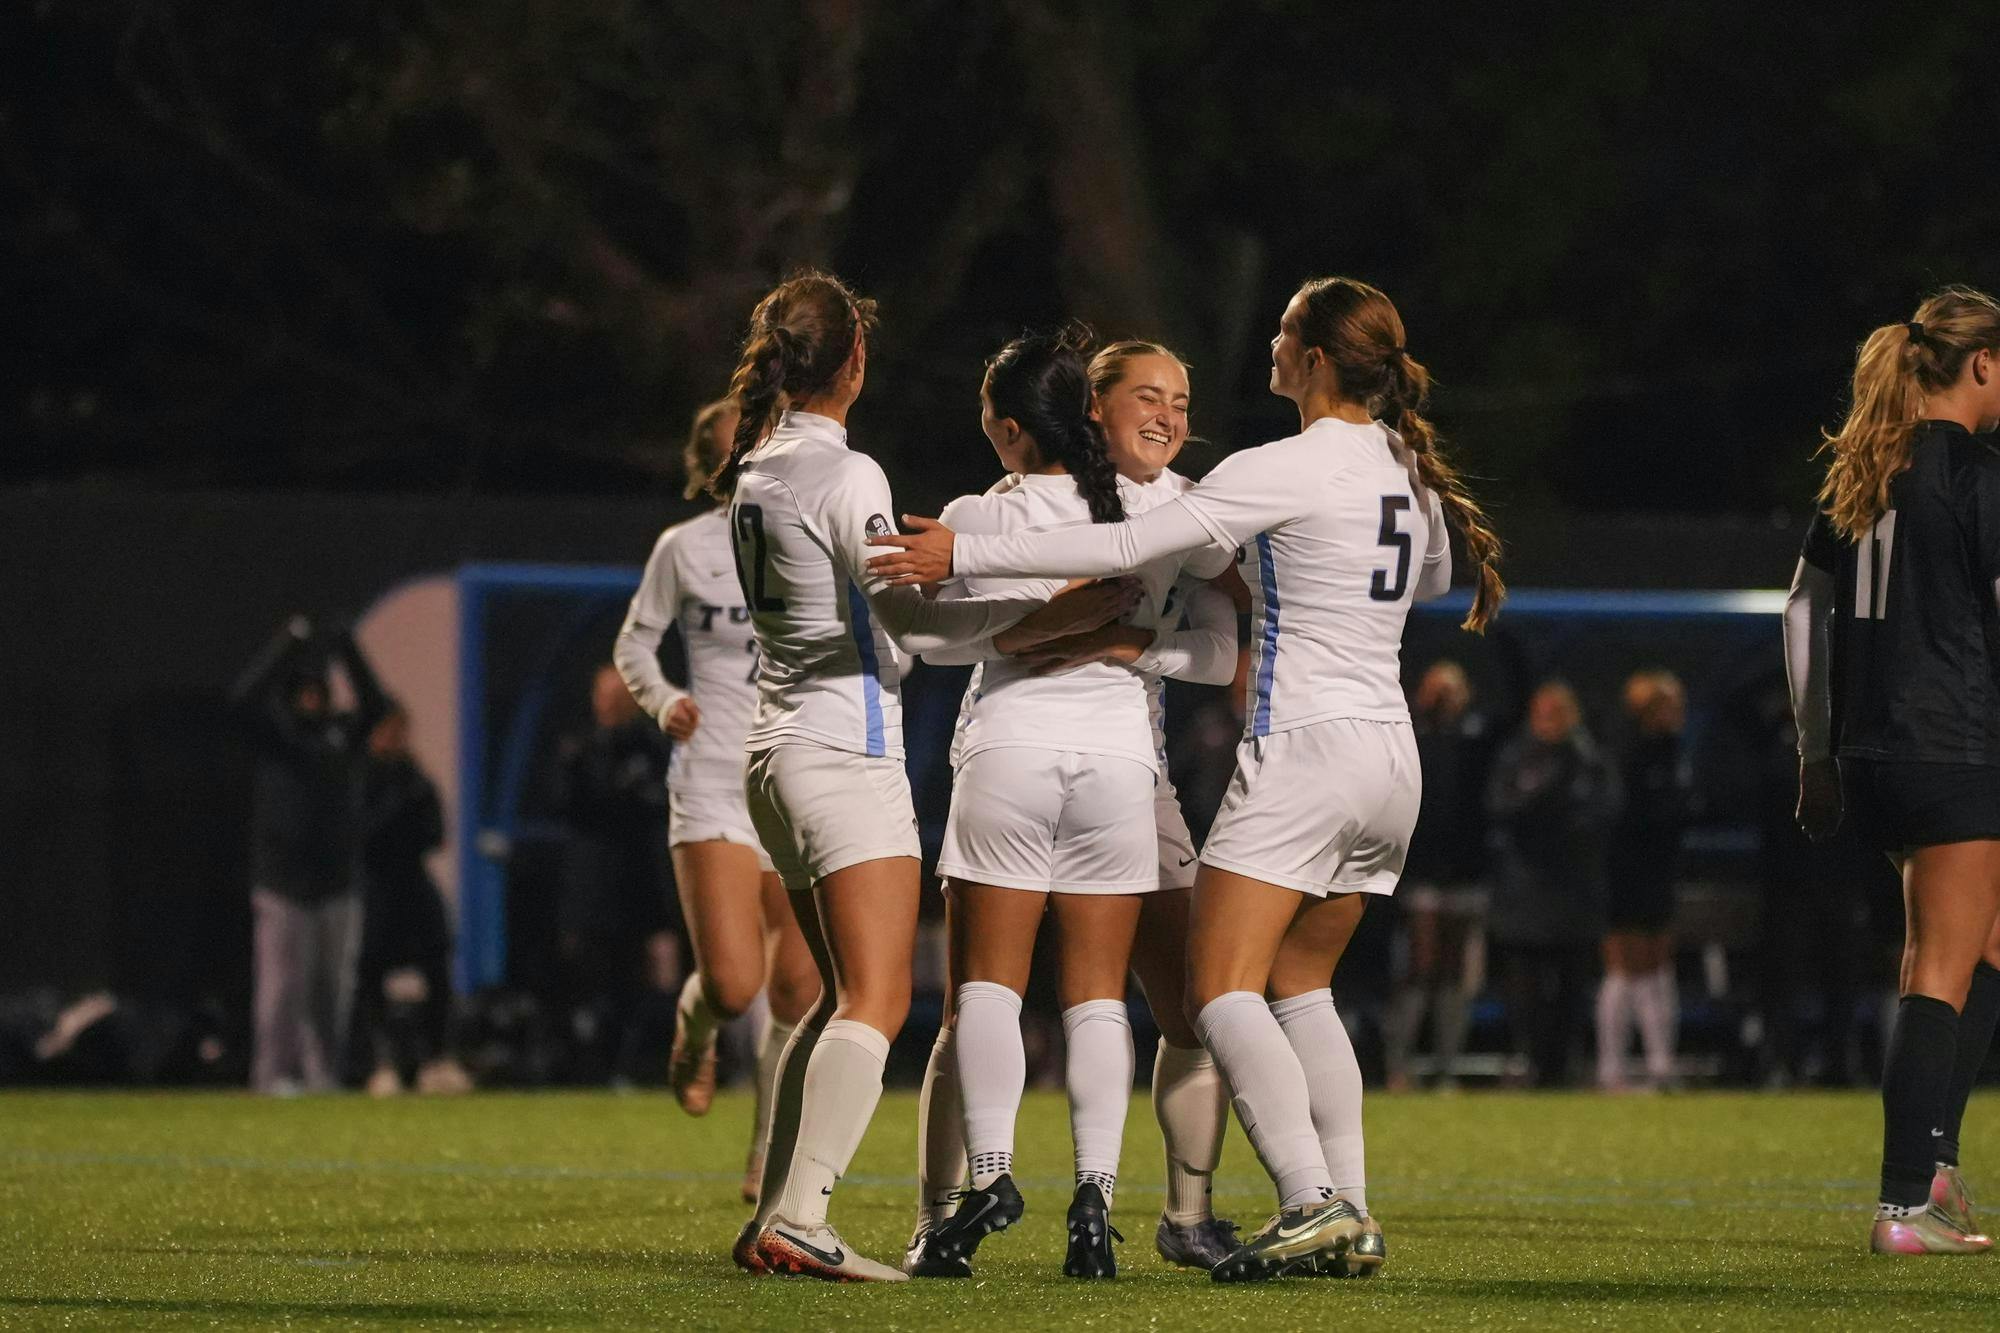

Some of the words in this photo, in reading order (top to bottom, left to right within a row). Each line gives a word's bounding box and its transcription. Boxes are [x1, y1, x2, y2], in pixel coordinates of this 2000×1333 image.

[731, 503, 787, 612] 12
[1369, 495, 1411, 602] 5
[1855, 509, 1897, 620] 11
